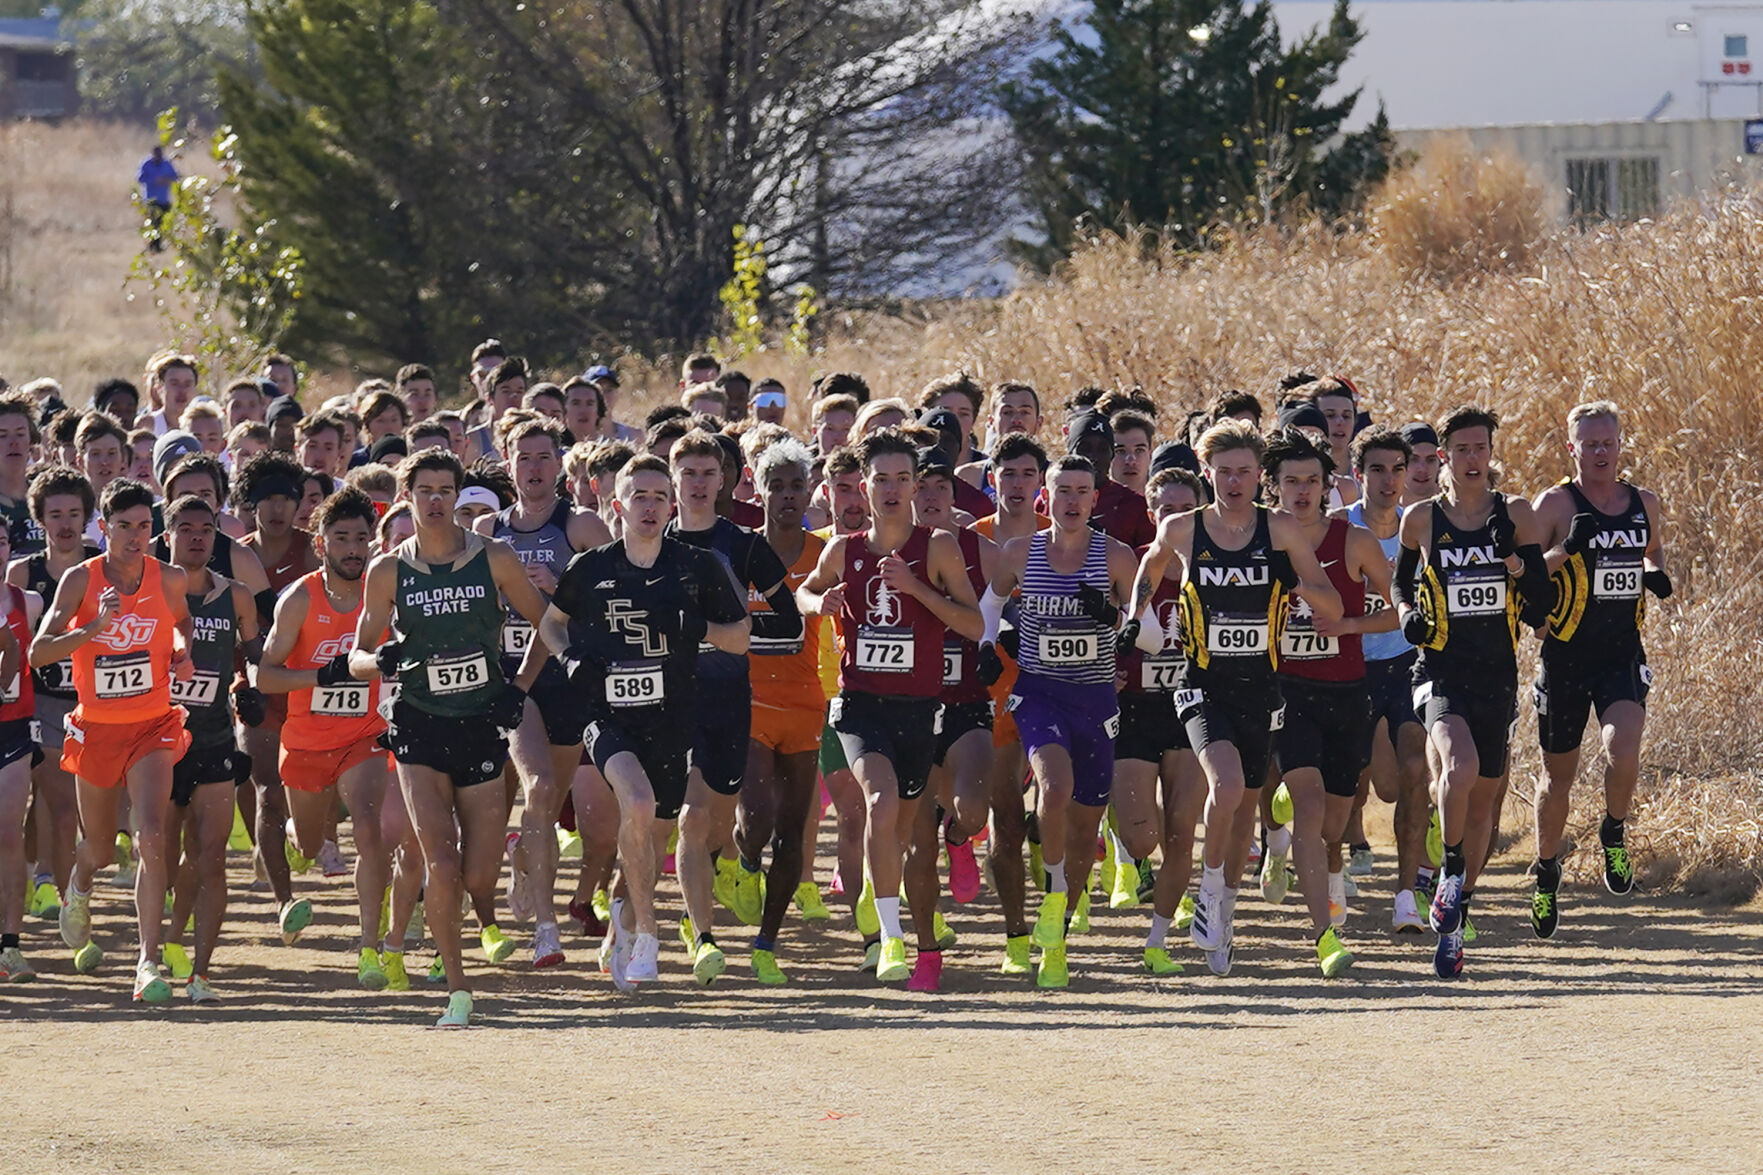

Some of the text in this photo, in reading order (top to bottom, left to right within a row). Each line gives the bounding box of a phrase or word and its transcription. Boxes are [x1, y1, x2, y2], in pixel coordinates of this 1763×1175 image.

[1588, 529, 1647, 549] NAU
[517, 549, 555, 563] TLER
[1198, 565, 1269, 587] NAU
[1603, 571, 1637, 592] 693
[406, 585, 485, 606] COLORADO
[1457, 586, 1498, 608] 699
[423, 600, 470, 617] STATE
[191, 616, 231, 632] RADO
[604, 599, 670, 657] FSU
[1047, 638, 1088, 658] 590
[1218, 628, 1259, 648] 690
[1288, 635, 1329, 652] 770
[864, 643, 905, 664] 772
[104, 668, 143, 690] 712
[437, 663, 479, 686] 578
[171, 677, 210, 698] 577
[613, 676, 655, 698] 589
[322, 690, 361, 710] 718
